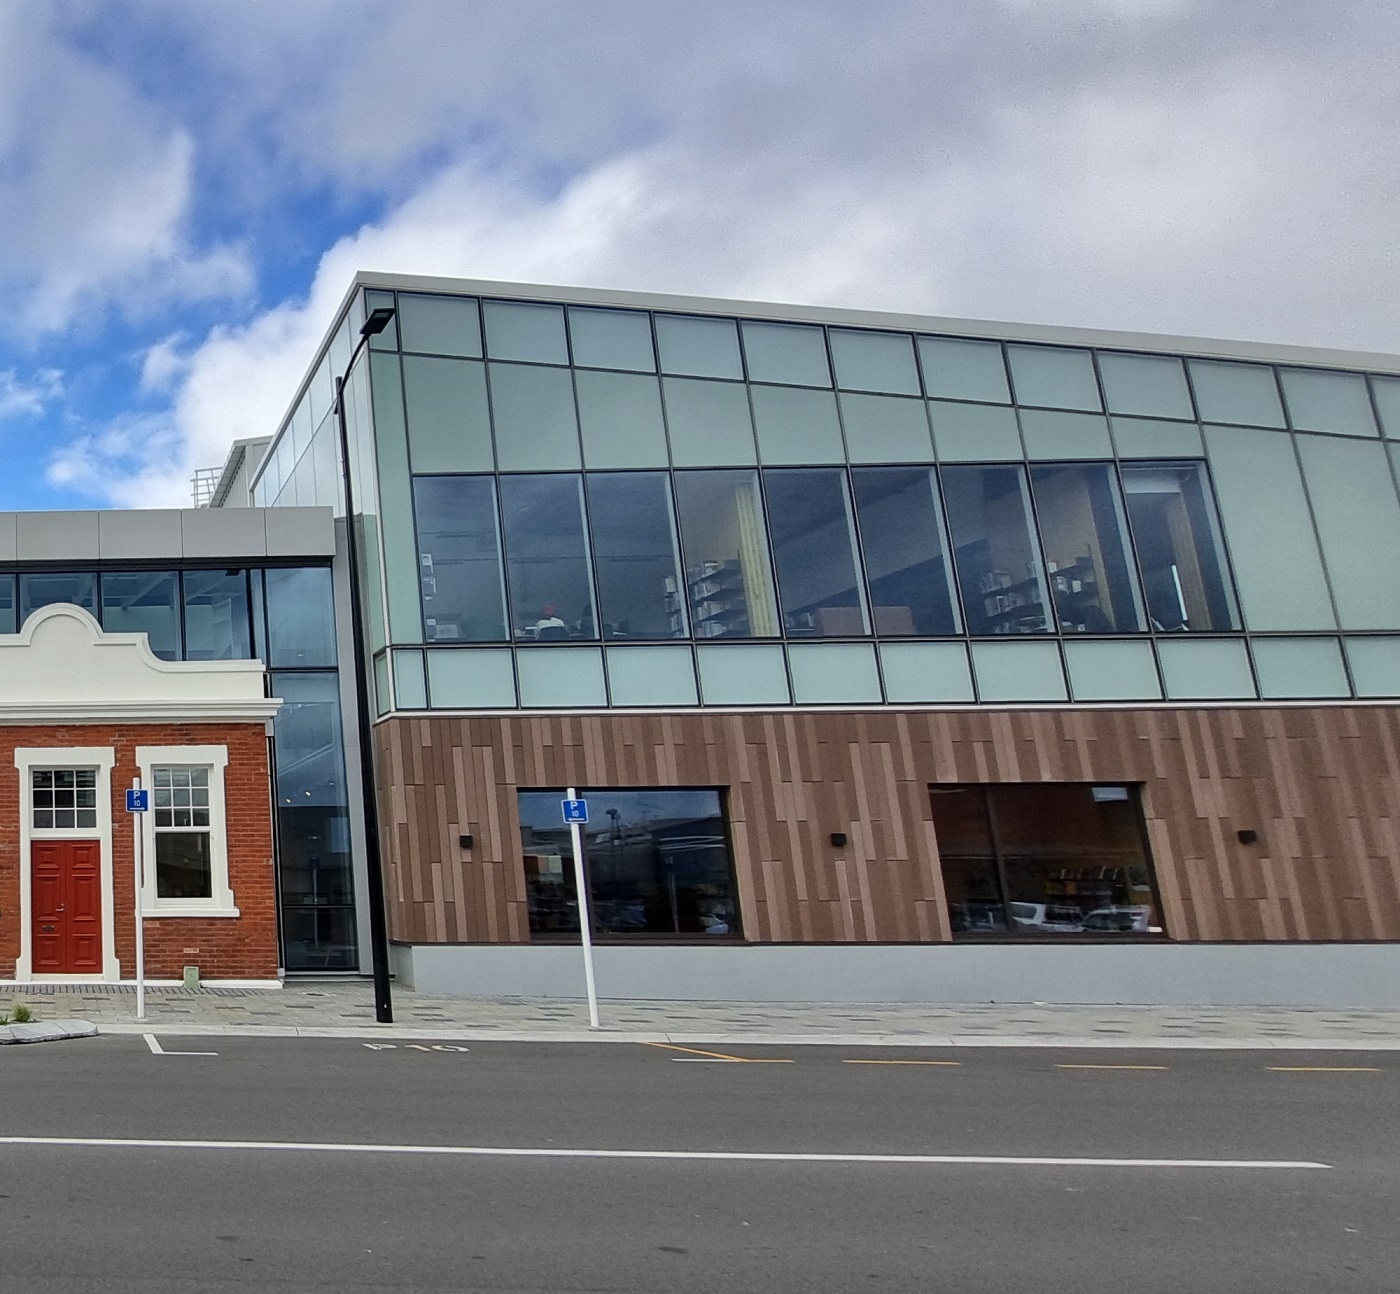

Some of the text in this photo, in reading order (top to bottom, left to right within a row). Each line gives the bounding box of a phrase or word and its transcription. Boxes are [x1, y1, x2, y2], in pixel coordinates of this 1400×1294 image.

[133, 791, 141, 800] P
[133, 799, 141, 807] 10
[570, 801, 579, 810] P
[362, 1043, 470, 1052] P10
